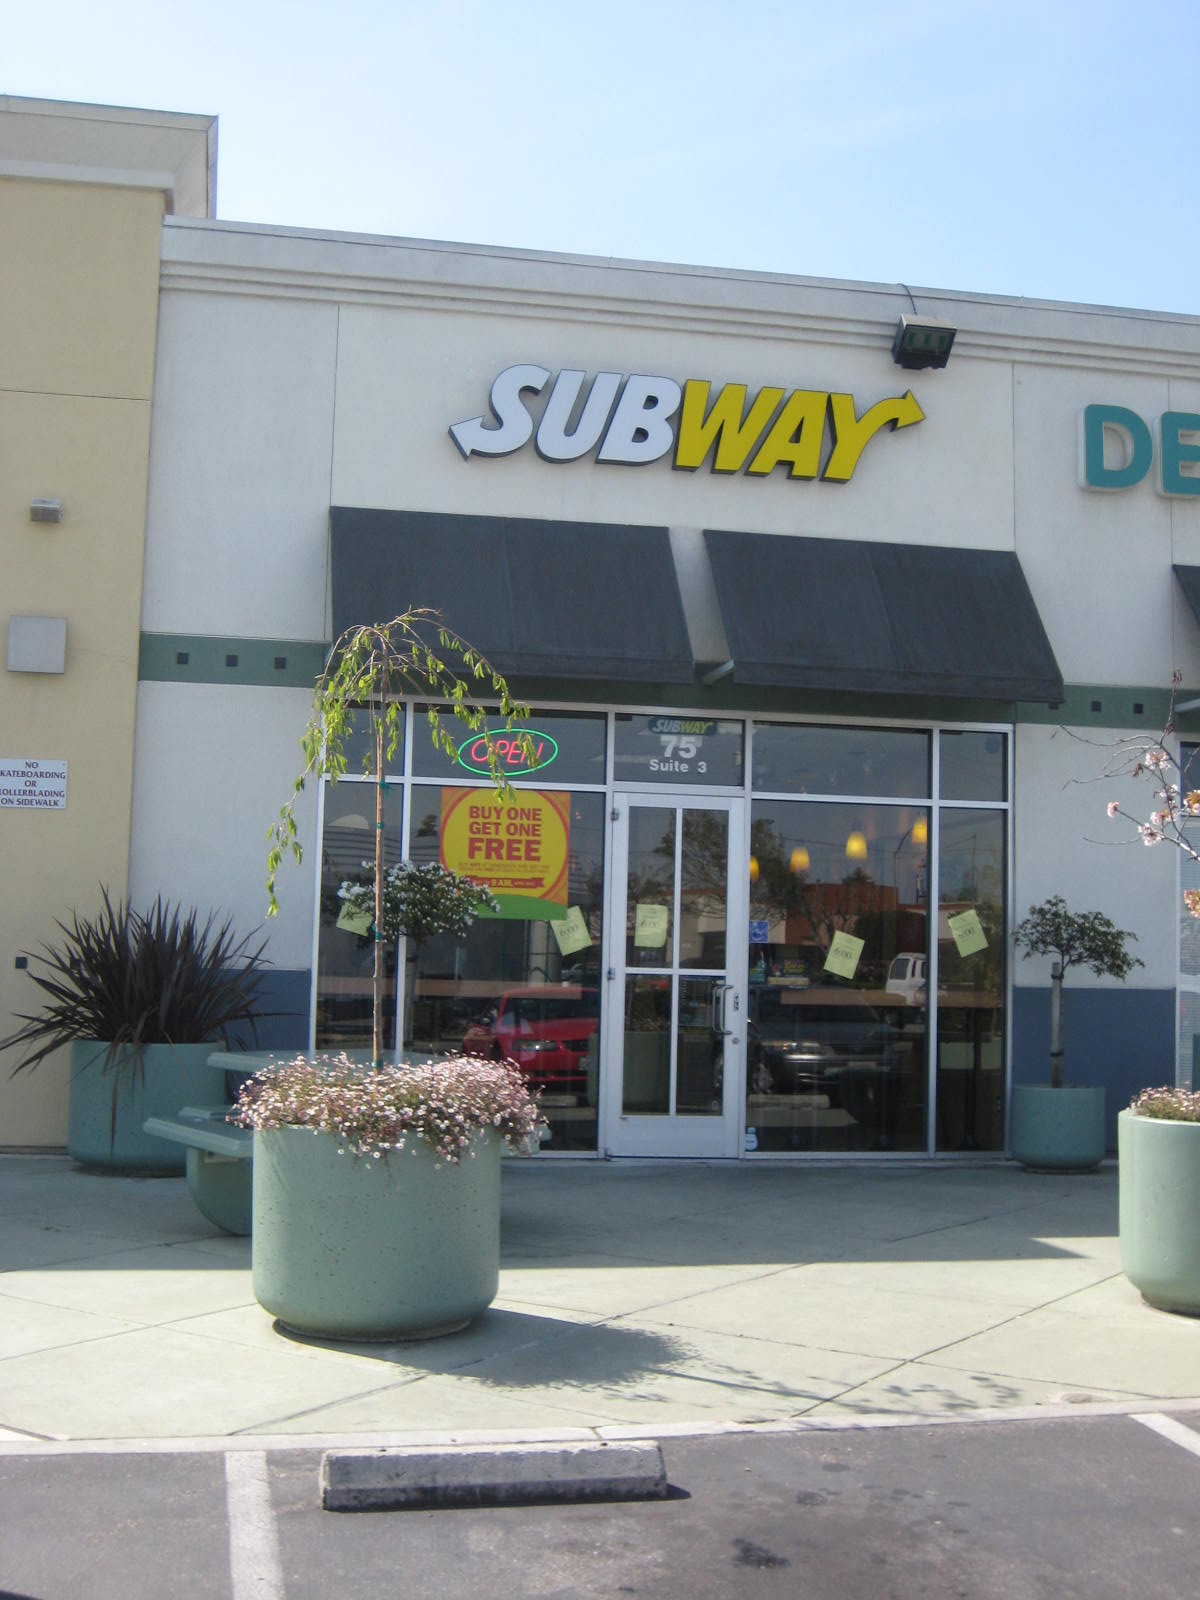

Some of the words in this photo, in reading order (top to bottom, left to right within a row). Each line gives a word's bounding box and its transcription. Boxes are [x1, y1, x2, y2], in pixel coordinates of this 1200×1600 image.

[449, 363, 926, 483] SUBWAY
[652, 719, 714, 734] SUBWAY
[661, 735, 697, 759] 75
[25, 761, 39, 769] NO
[649, 759, 689, 773] Suite
[697, 761, 707, 773] 3
[24, 780, 37, 788] OR
[16, 798, 60, 807] SIDEWALK
[469, 806, 504, 820] BUY
[506, 807, 542, 821] ONE
[469, 821, 502, 835] GET
[506, 823, 542, 837] ONE
[468, 838, 541, 862] FREE
